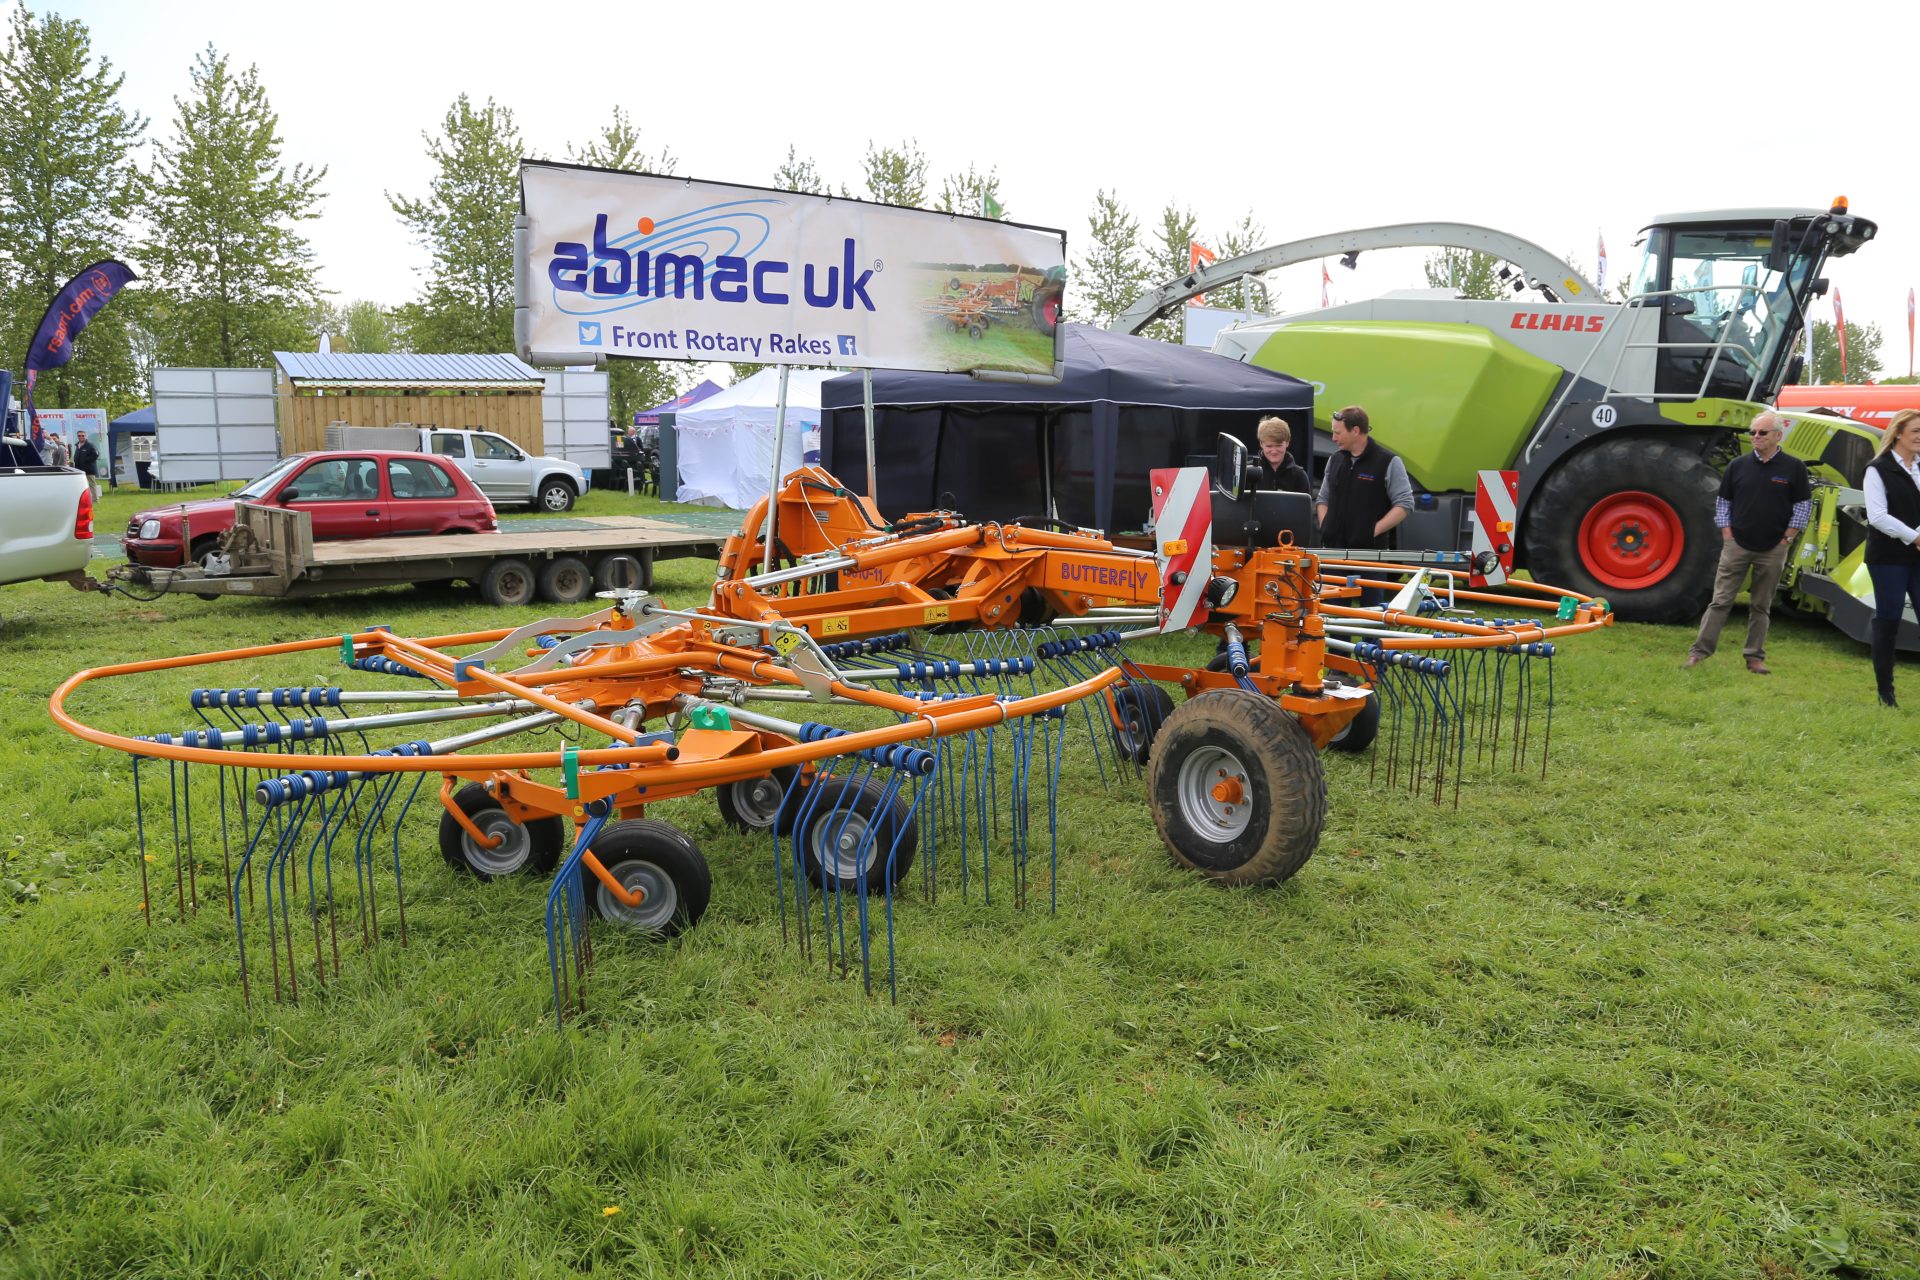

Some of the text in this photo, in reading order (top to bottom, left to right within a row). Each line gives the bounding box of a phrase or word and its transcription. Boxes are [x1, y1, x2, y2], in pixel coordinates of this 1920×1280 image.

[548, 213, 876, 312] abimac uk
[1510, 312, 1605, 333] CLAAS
[612, 325, 832, 357] Front Rotary Rakes
[1595, 408, 1612, 423] 40
[1061, 562, 1148, 590] BUTTERFLY
